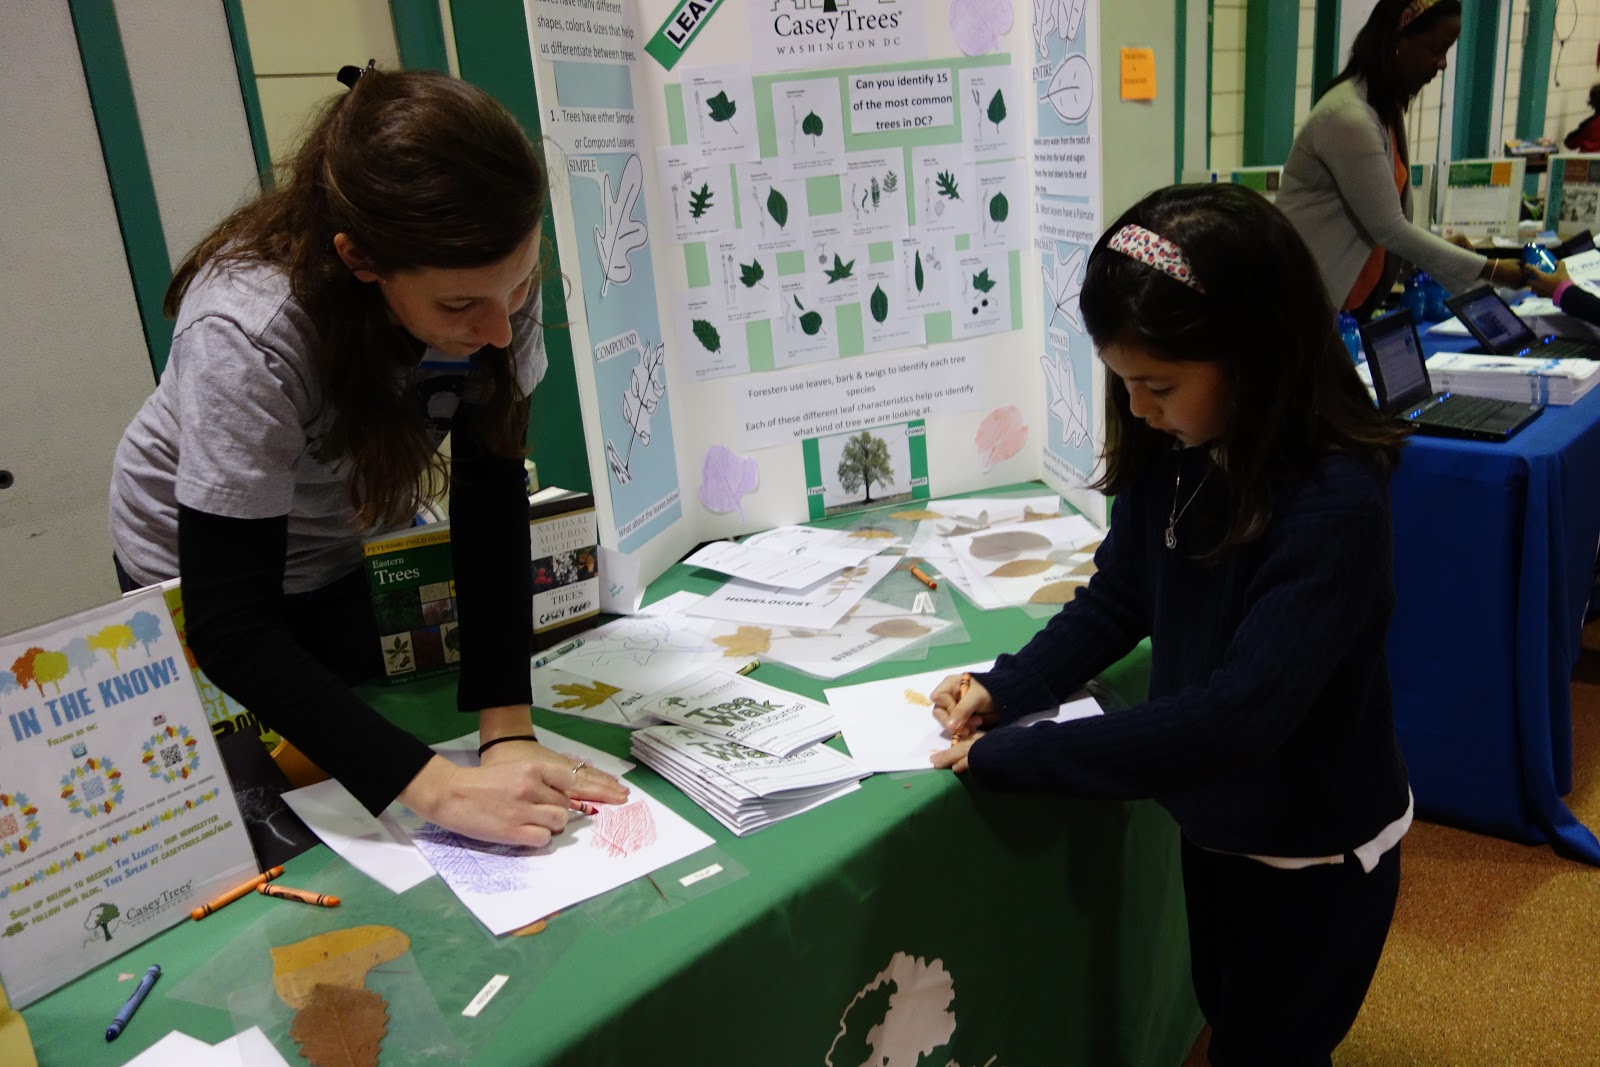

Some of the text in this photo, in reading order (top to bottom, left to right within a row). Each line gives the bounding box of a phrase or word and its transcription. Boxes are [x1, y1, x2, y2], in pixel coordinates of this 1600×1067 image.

[578, 0, 622, 14] many different
[537, 14, 634, 40] shapes, colors & sizes that help
[667, 0, 713, 44] LEA
[774, 10, 899, 40] Casey Trees
[540, 41, 637, 60] us differentiate between trees.
[776, 38, 901, 55] WASHINGTON DC
[1033, 64, 1052, 80] ENTIRE
[856, 73, 948, 90] Can you identify 15
[853, 95, 952, 110] of the most common
[551, 110, 634, 125] 1. Trees have either Simple
[876, 116, 933, 130] trees in DC?
[574, 136, 636, 150] or Compound Leaves
[1060, 136, 1068, 144] from
[1076, 136, 1086, 144] roots
[1086, 135, 1090, 144] of
[569, 160, 596, 172] SIMPLE
[1073, 154, 1086, 164] sugars
[1054, 170, 1063, 178] down
[1041, 204, 1094, 221] Most leaves have Palmate
[1058, 228, 1066, 236] vein
[595, 332, 638, 361] COMPOUND
[1050, 332, 1068, 348] PINNATE
[748, 386, 788, 398] Foresters
[790, 383, 804, 391] use
[806, 378, 834, 388] leaves,
[836, 372, 854, 384] bark
[856, 372, 862, 380] &
[865, 369, 886, 378] twigs
[898, 361, 928, 373] identify
[930, 358, 948, 368] each
[950, 356, 966, 364] tree
[846, 385, 876, 397] species
[746, 420, 766, 431] Each
[768, 418, 776, 426] of
[778, 416, 800, 425] these
[802, 408, 838, 421] different
[840, 404, 855, 414] leaf
[858, 394, 914, 411] characteristics
[916, 391, 932, 402] help
[945, 384, 974, 396] identify
[794, 406, 932, 437] what kind of tree we are looking at.
[904, 427, 924, 436] Crown
[809, 486, 827, 495] Trunk
[618, 523, 632, 538] What
[632, 514, 645, 529] about
[653, 500, 666, 514] leaves
[666, 488, 680, 505] below?
[537, 516, 588, 533] NATIONAL
[540, 526, 588, 544] AUDUBON
[367, 542, 404, 553] PETERSON
[542, 539, 584, 554] SOCIETY
[372, 558, 404, 569] Eastern
[374, 568, 420, 586] Trees
[551, 589, 584, 605] TREES
[725, 597, 812, 607] HONELOCUST
[540, 608, 564, 624] CASEY
[8, 707, 42, 742] IN
[44, 688, 96, 728] THE
[98, 656, 180, 708] KNOW!
[684, 697, 756, 720] Tree
[704, 700, 784, 727] Walk
[726, 721, 760, 739] Field
[762, 702, 806, 723] Journal
[46, 886, 71, 904] BELOW
[74, 880, 84, 888] TO
[86, 866, 113, 884] RECEIVE
[115, 856, 130, 868] THE
[164, 834, 178, 846] OUR
[180, 814, 218, 837] NEWSLETTER
[32, 905, 60, 925] FOLLOW
[63, 896, 79, 908] OUR
[151, 856, 159, 866] AT
[161, 820, 233, 860] CASEYTREES.ORG/BLOG
[126, 881, 191, 920] Casey Trees
